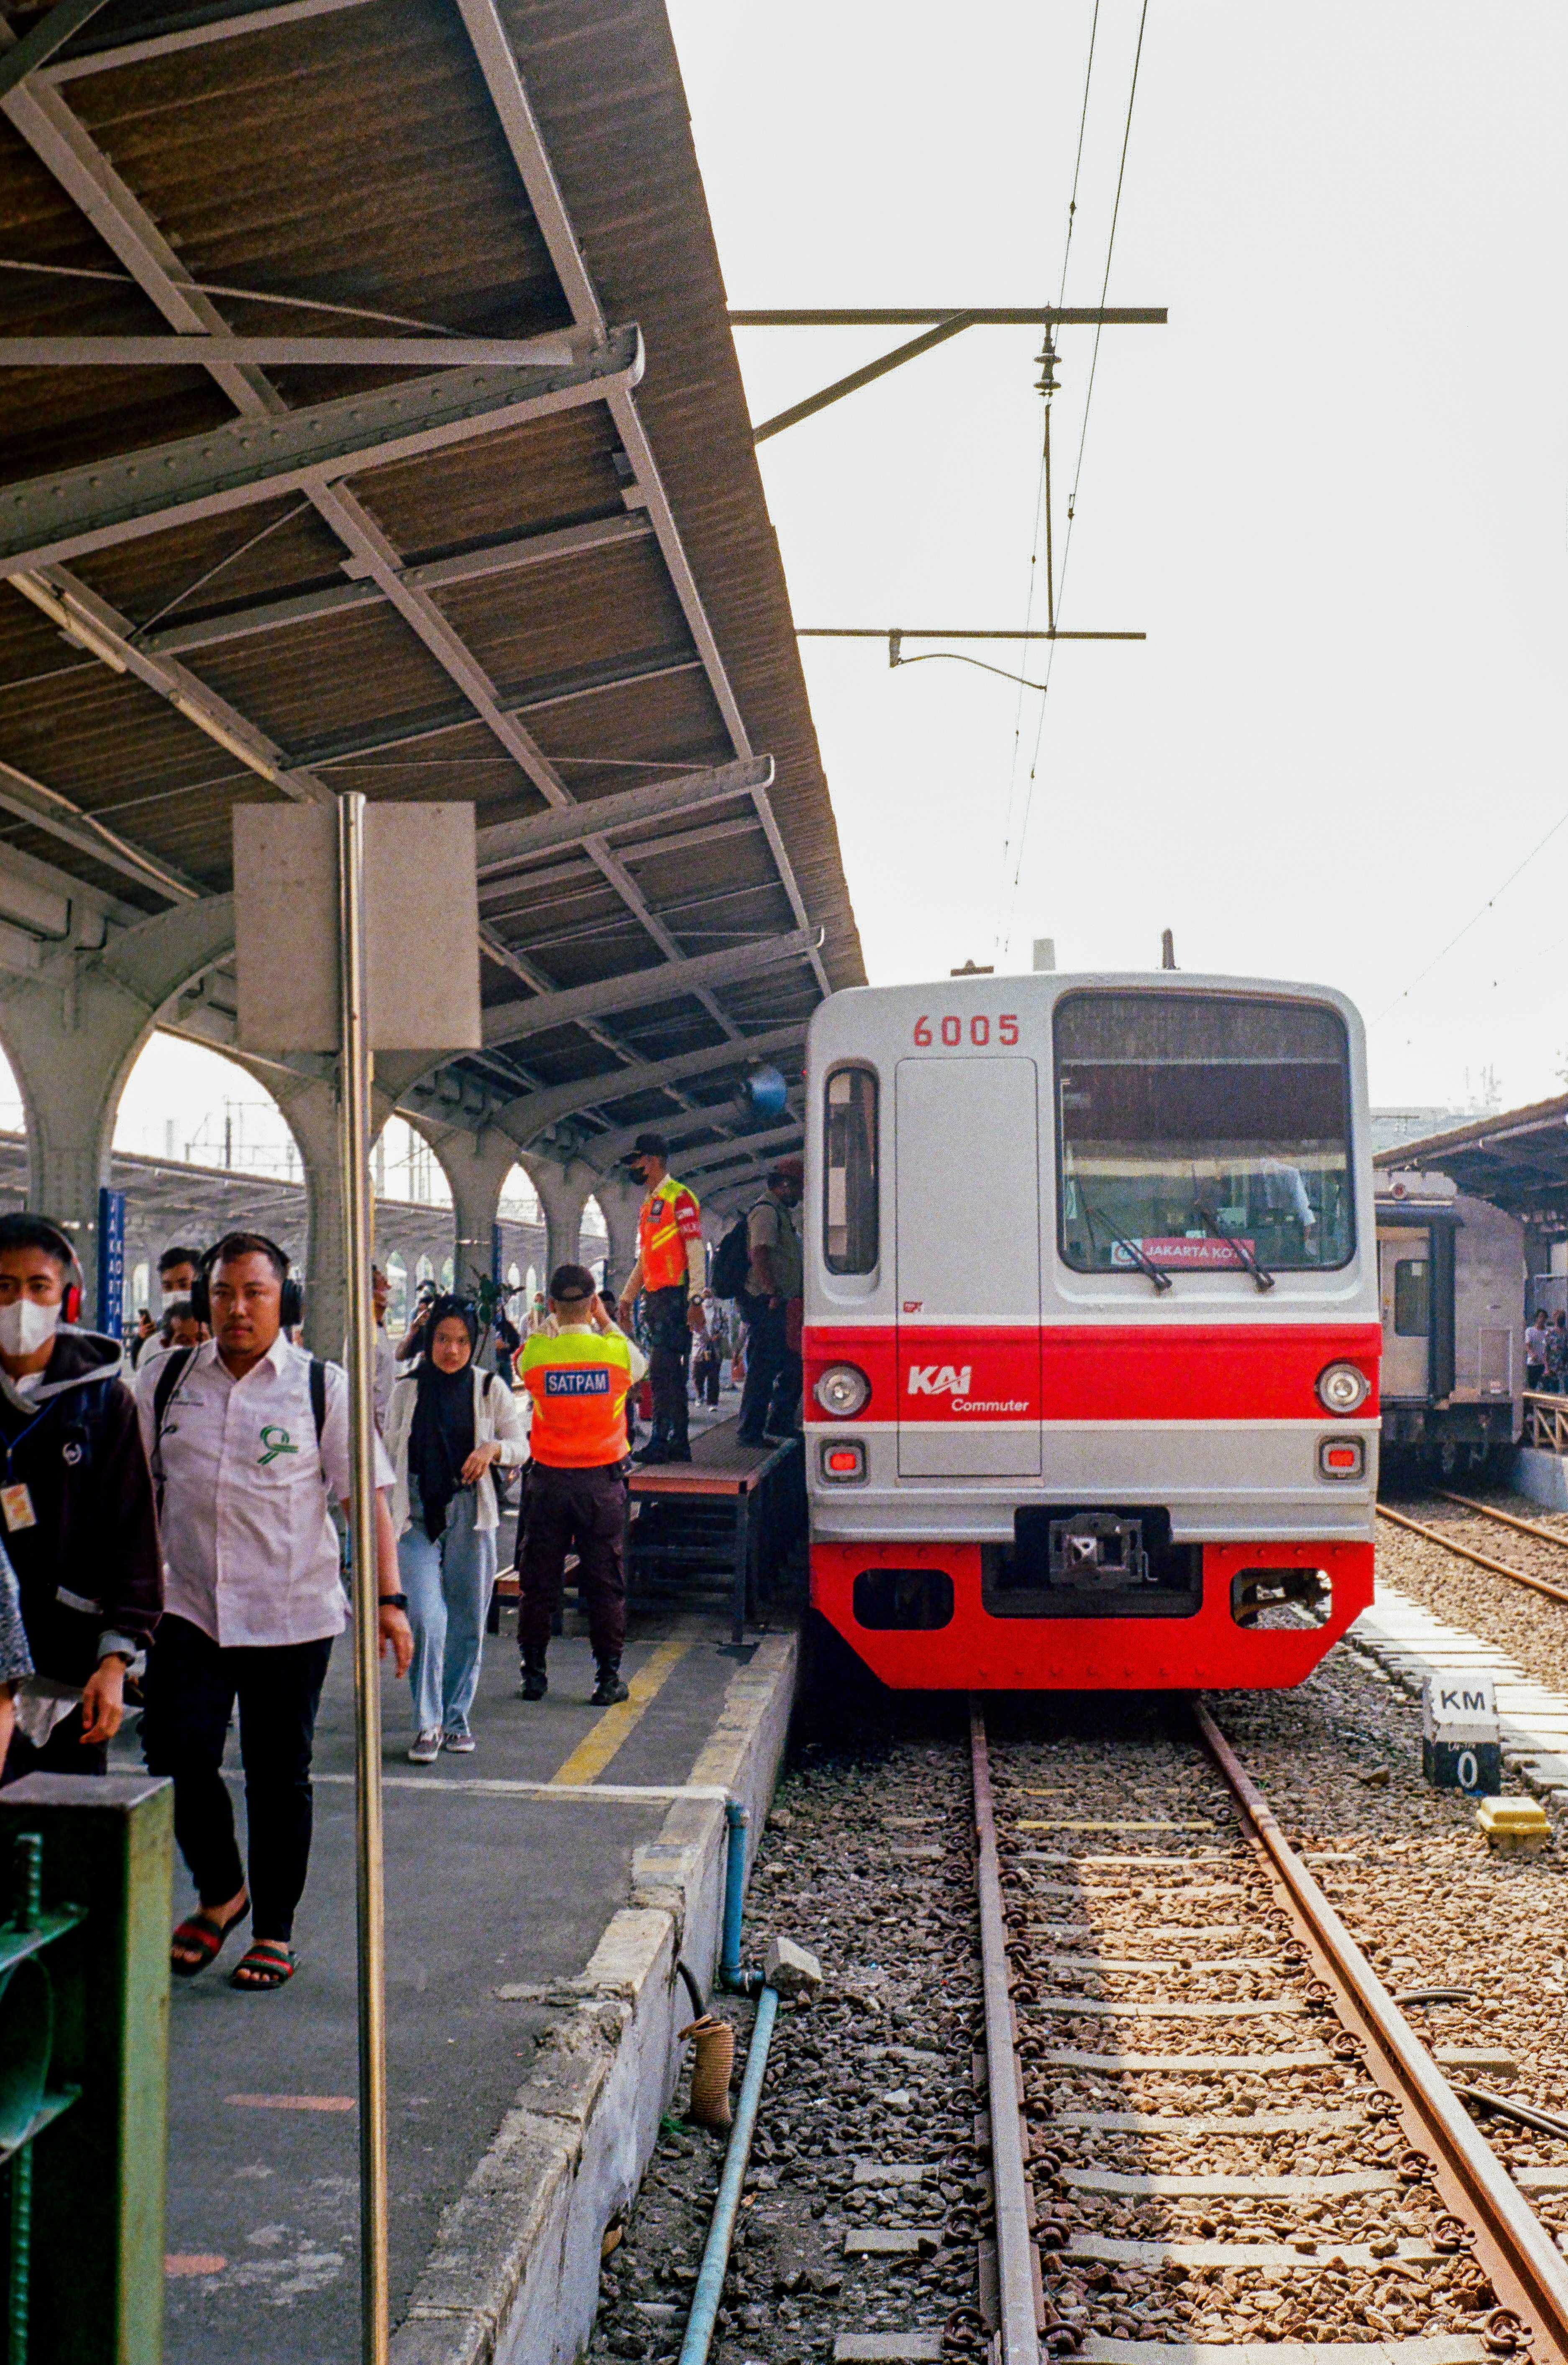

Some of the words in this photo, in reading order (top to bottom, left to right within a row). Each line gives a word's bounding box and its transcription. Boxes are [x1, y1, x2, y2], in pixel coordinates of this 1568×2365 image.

[913, 1014, 1019, 1046] 6005
[1146, 1245, 1209, 1257] JAKARTA
[107, 1197, 116, 1334] JAKARTA
[548, 1374, 607, 1391] SATPAM
[908, 1366, 972, 1394] KAI
[952, 1398, 1029, 1412] Commuter
[1440, 1690, 1485, 1710] KM
[1457, 1750, 1478, 1789] 0
